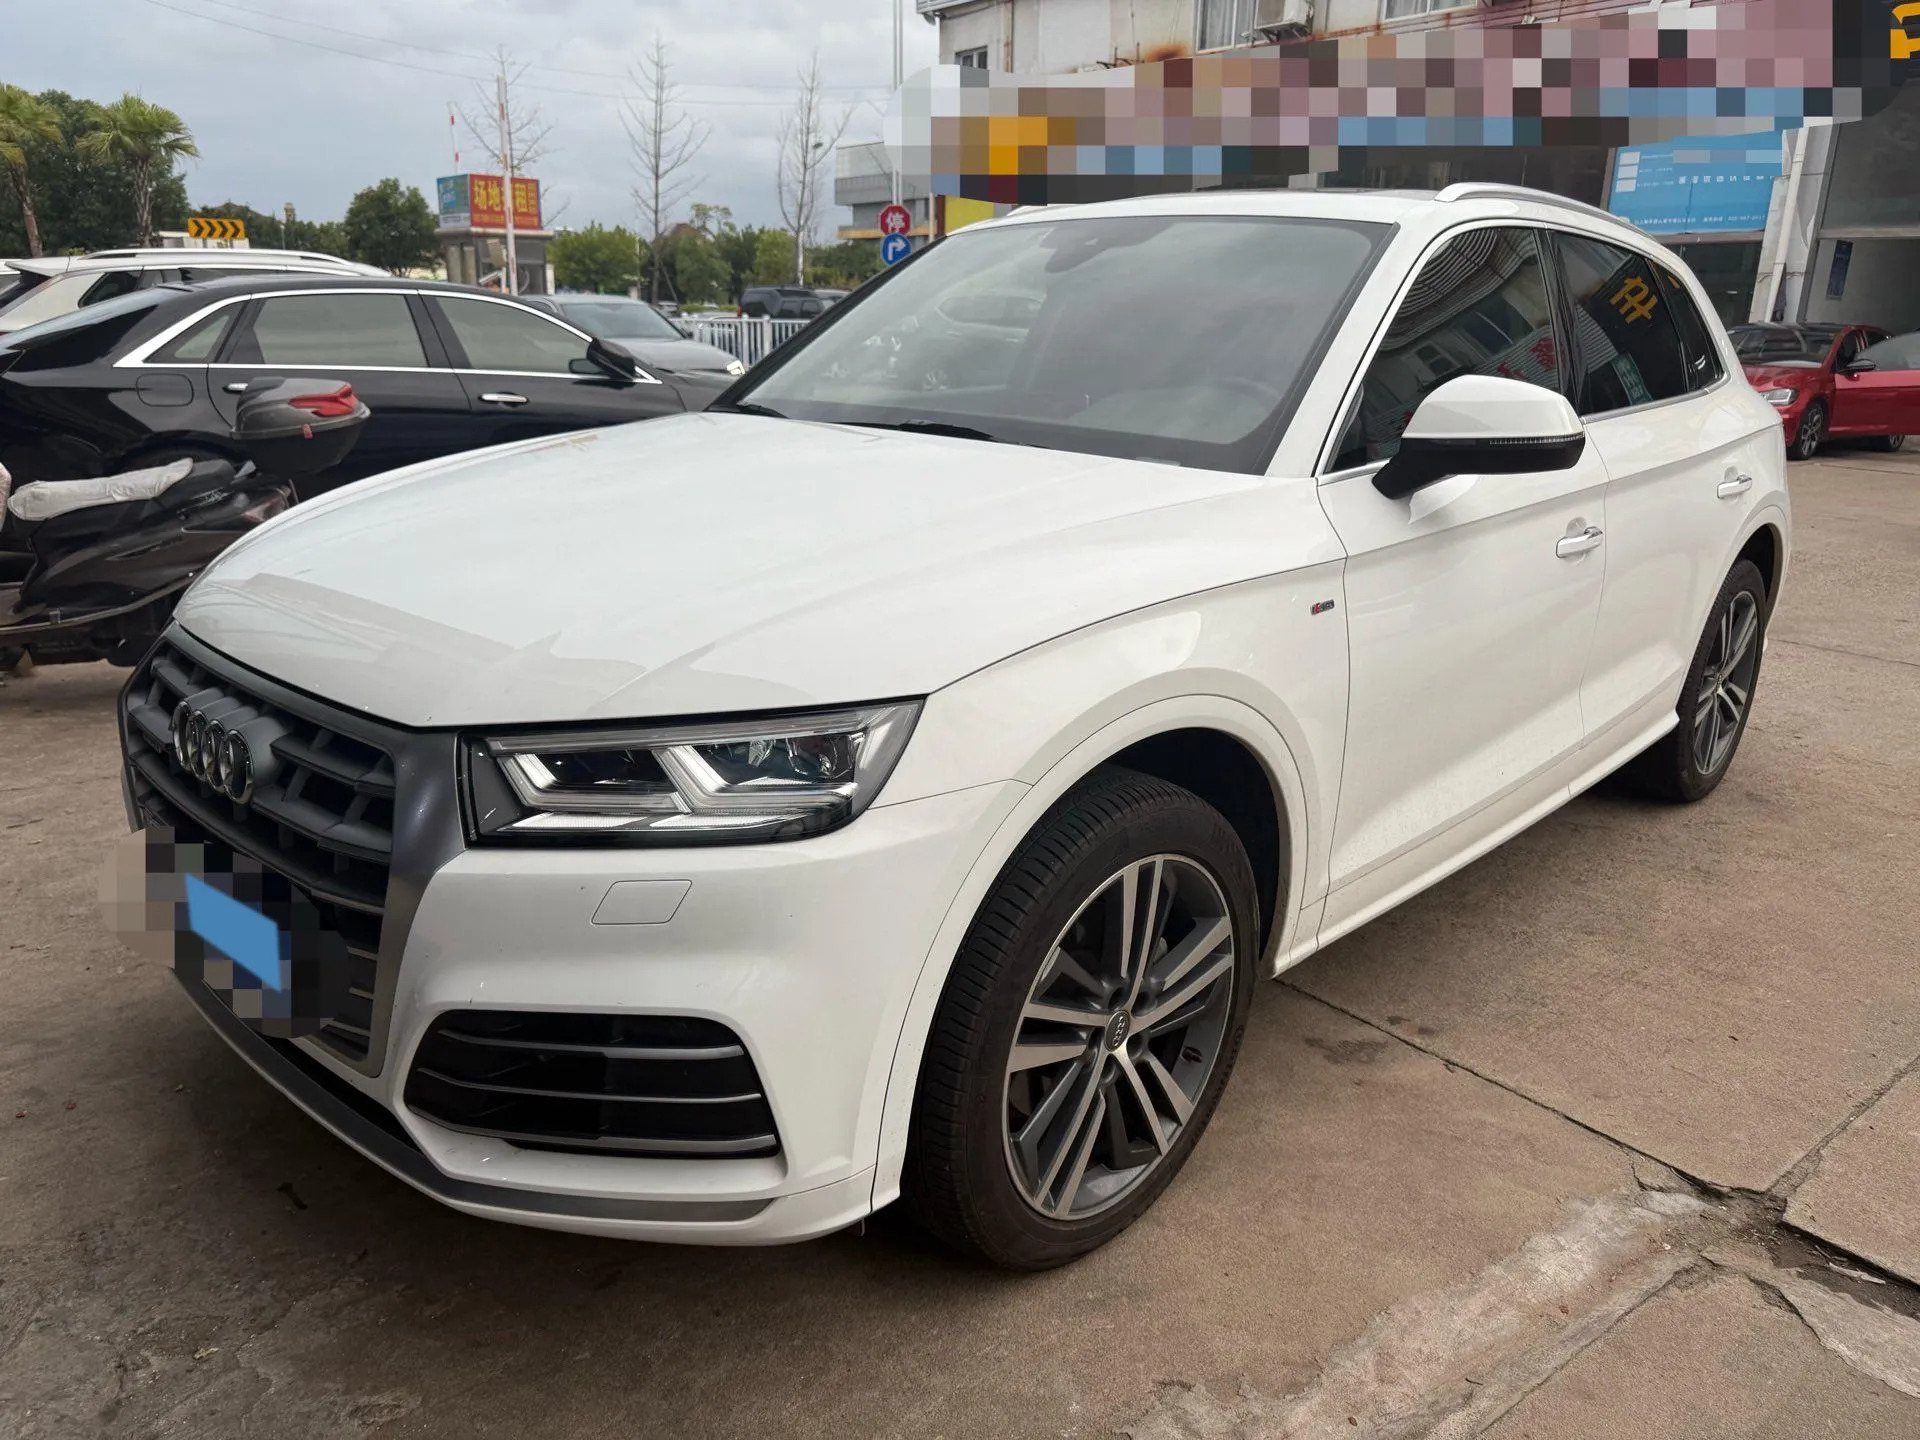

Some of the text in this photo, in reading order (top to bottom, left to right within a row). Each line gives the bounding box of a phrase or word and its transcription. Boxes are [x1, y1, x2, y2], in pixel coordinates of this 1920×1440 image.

[473, 179, 529, 212] 场地租
[886, 211, 906, 233] 停
